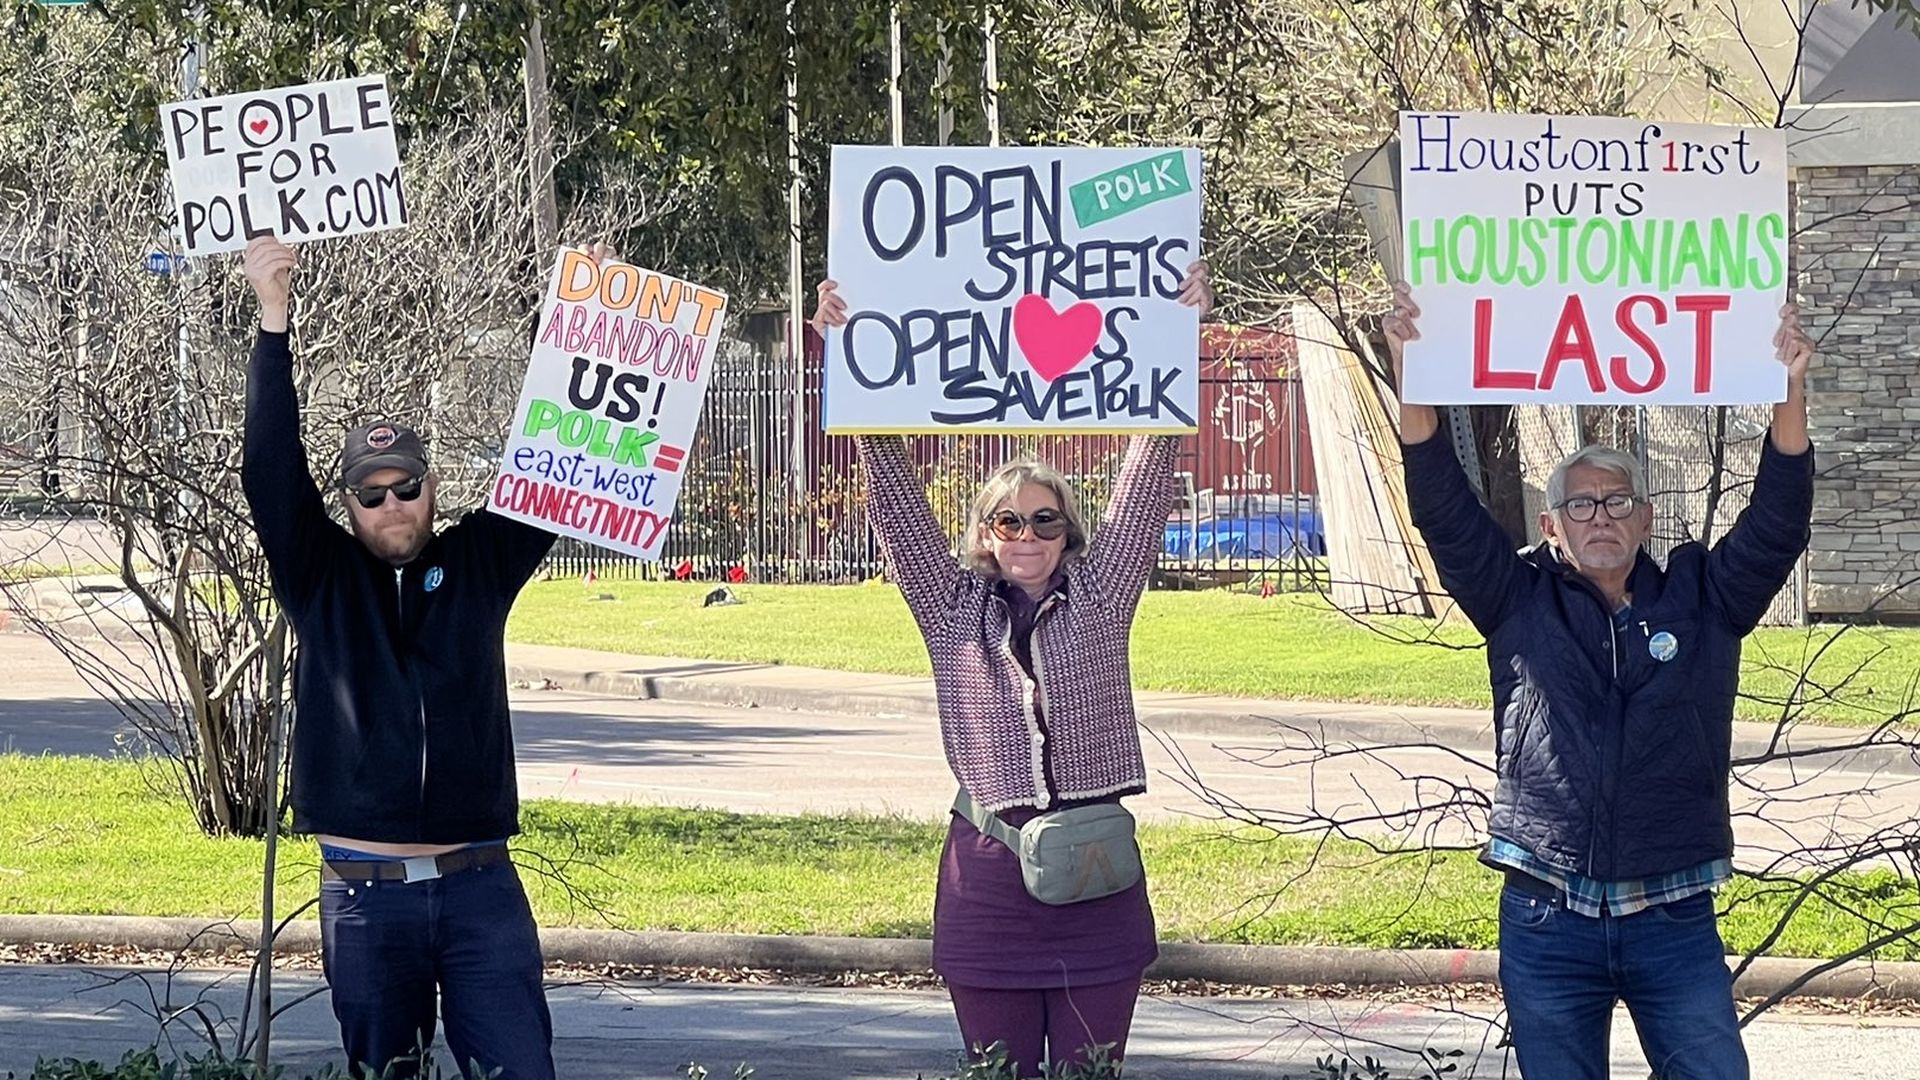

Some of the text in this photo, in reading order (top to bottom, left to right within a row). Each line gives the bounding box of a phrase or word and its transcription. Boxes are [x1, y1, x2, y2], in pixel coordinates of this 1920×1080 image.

[171, 83, 389, 160] PEOPLE
[237, 143, 336, 188] FOR
[1094, 158, 1180, 211] POLK
[1526, 182, 1644, 216] PUTS
[183, 166, 408, 249] POLK.COM
[862, 160, 1063, 262] OPEN
[964, 236, 1189, 301] STREETS
[1409, 212, 1784, 292] HOUSTONIANS
[557, 251, 725, 337] DON'T
[540, 303, 706, 382] ABANDON
[842, 306, 1011, 390] OPEN
[1473, 294, 1731, 394] LAST
[568, 357, 666, 429] US!
[931, 370, 1091, 425] SAVE
[494, 473, 669, 550] CONNECTIVITY
[514, 447, 657, 506] east-west
